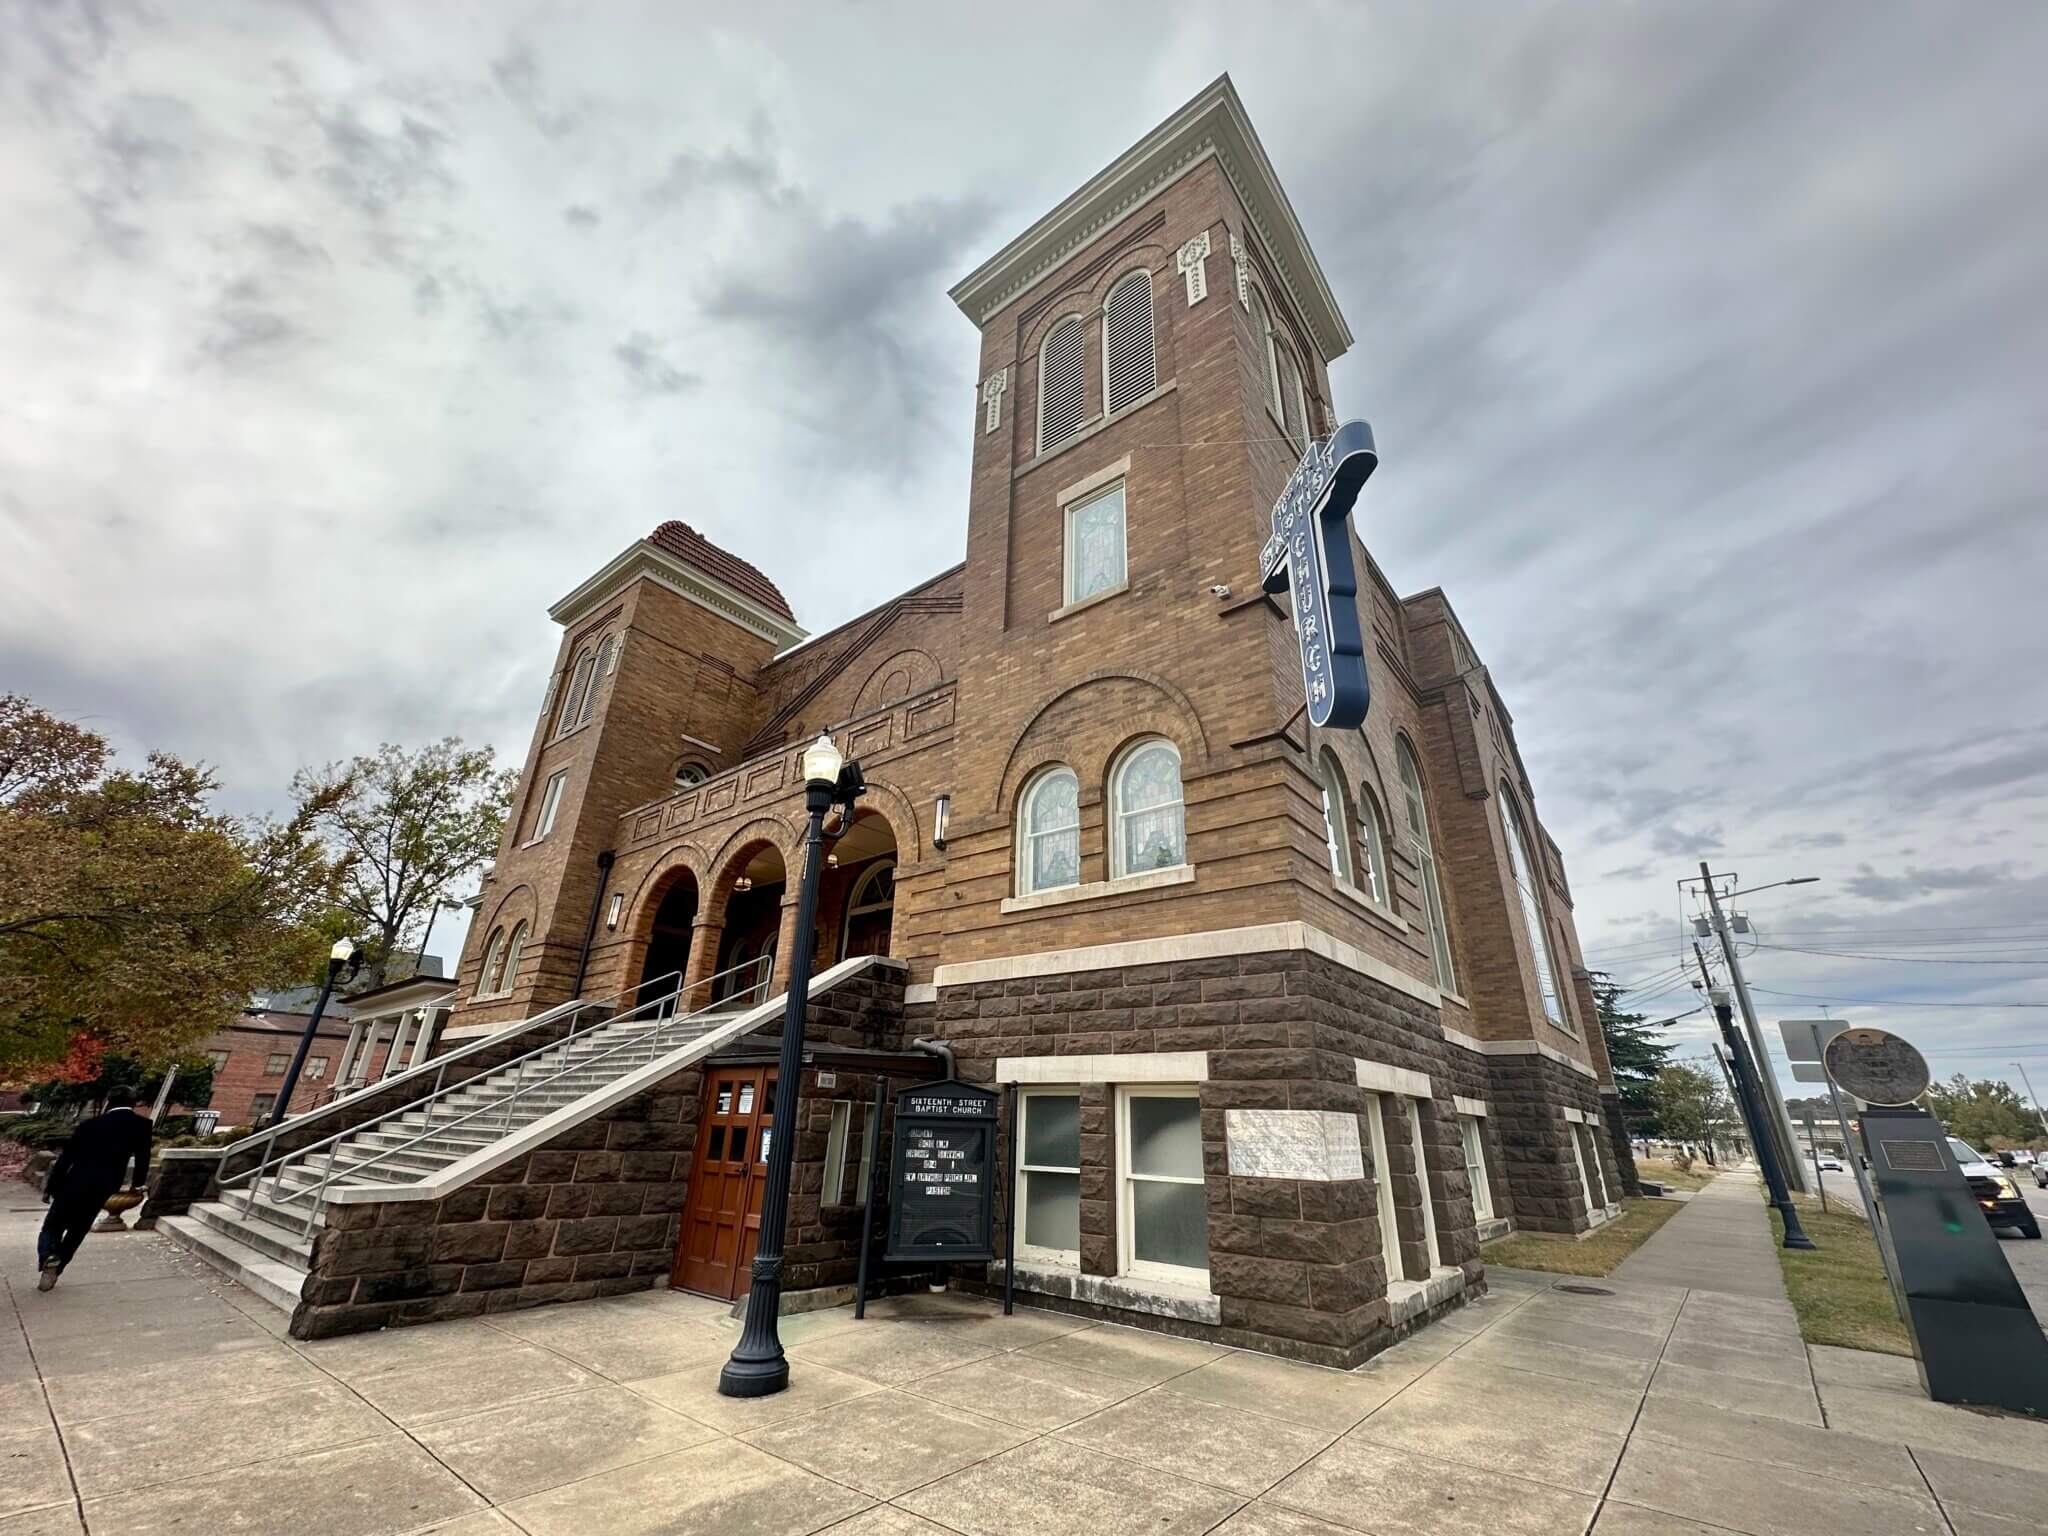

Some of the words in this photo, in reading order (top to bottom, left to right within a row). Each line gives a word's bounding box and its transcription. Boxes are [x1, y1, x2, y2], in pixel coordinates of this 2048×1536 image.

[1263, 443, 1335, 575] BAPTIST
[1291, 532, 1326, 704] CHURCH
[911, 1097, 952, 1106] SIXTEENTH
[958, 1099, 987, 1107] STREET
[915, 1105, 948, 1113] BAPTIST
[952, 1106, 982, 1114] CHURCH
[944, 1173, 963, 1182] PRICE
[925, 1186, 951, 1196] PASTOR
